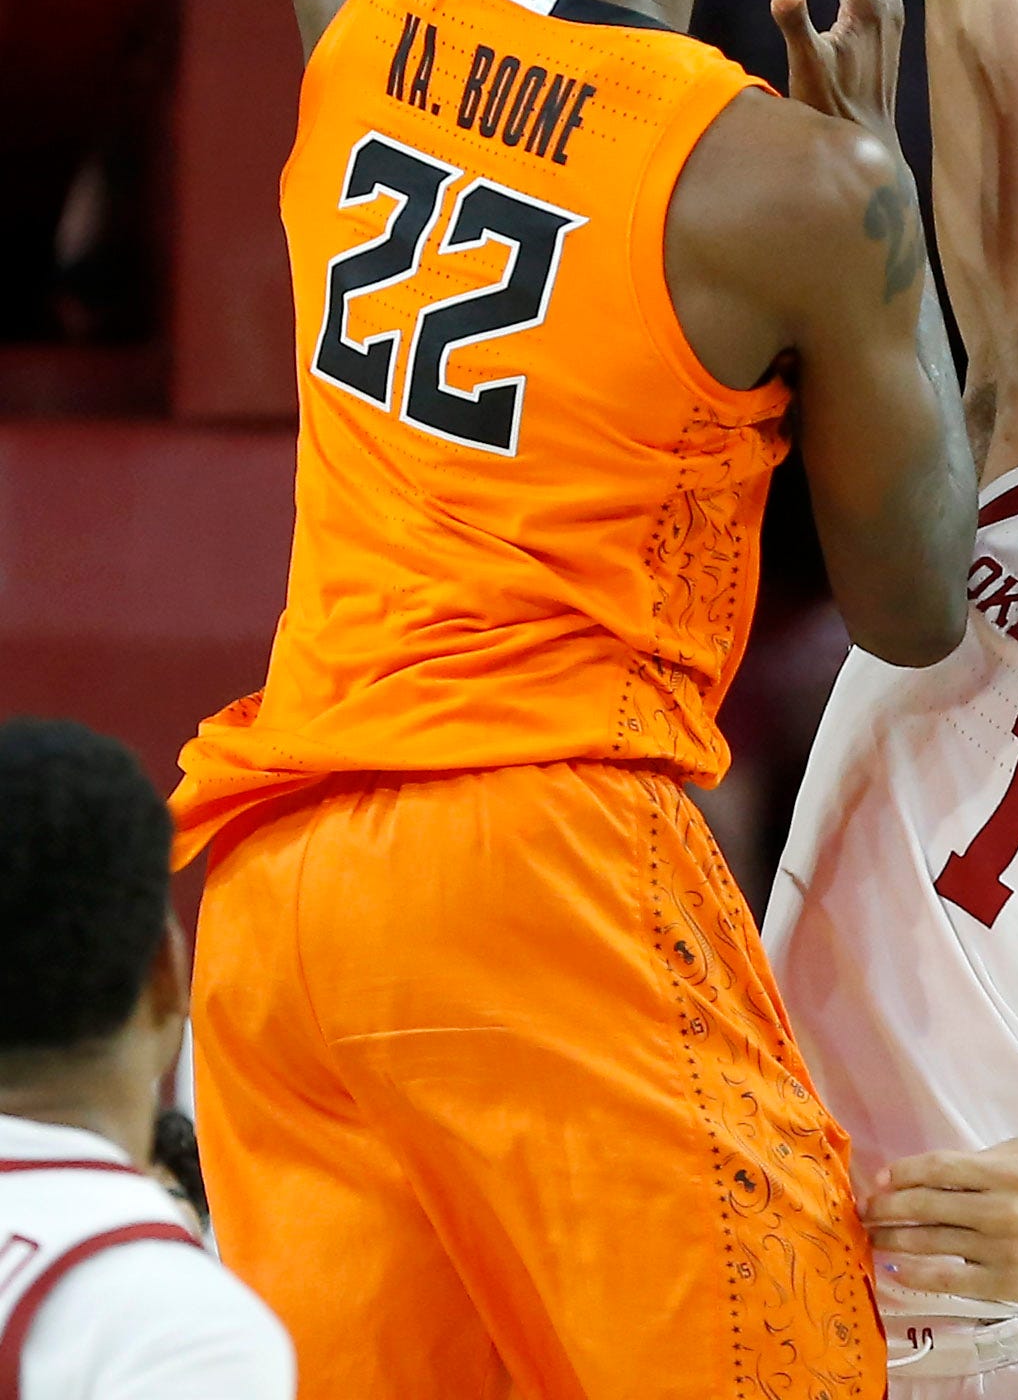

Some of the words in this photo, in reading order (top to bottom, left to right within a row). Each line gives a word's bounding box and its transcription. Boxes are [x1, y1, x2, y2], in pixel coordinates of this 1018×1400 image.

[386, 12, 441, 116] KA.
[456, 43, 597, 166] BOONE
[311, 129, 590, 457] 22
